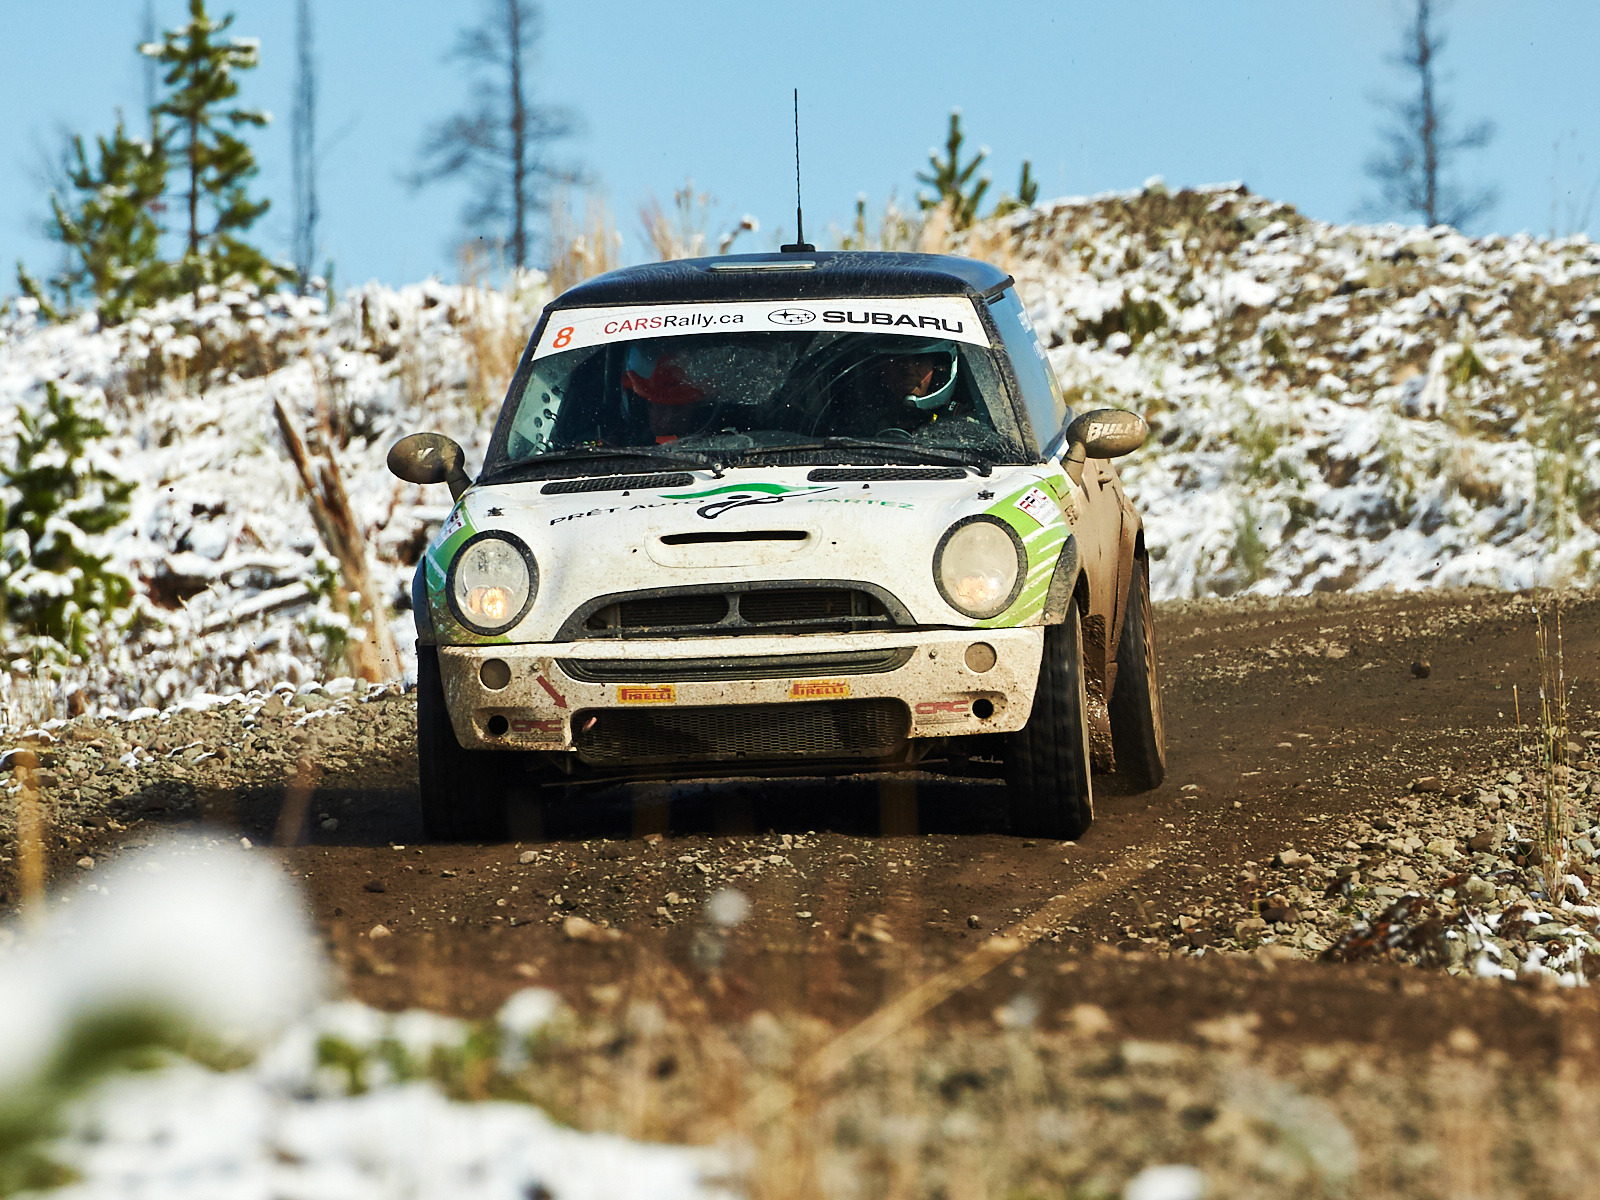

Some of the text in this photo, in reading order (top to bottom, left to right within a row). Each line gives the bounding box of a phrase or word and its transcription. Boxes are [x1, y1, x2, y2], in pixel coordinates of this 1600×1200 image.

[604, 314, 744, 334] CARSRally.ca
[822, 310, 964, 334] SUBARU
[553, 327, 575, 349] 8
[621, 687, 672, 700] PIRELLI
[793, 682, 845, 696] PIRELLI
